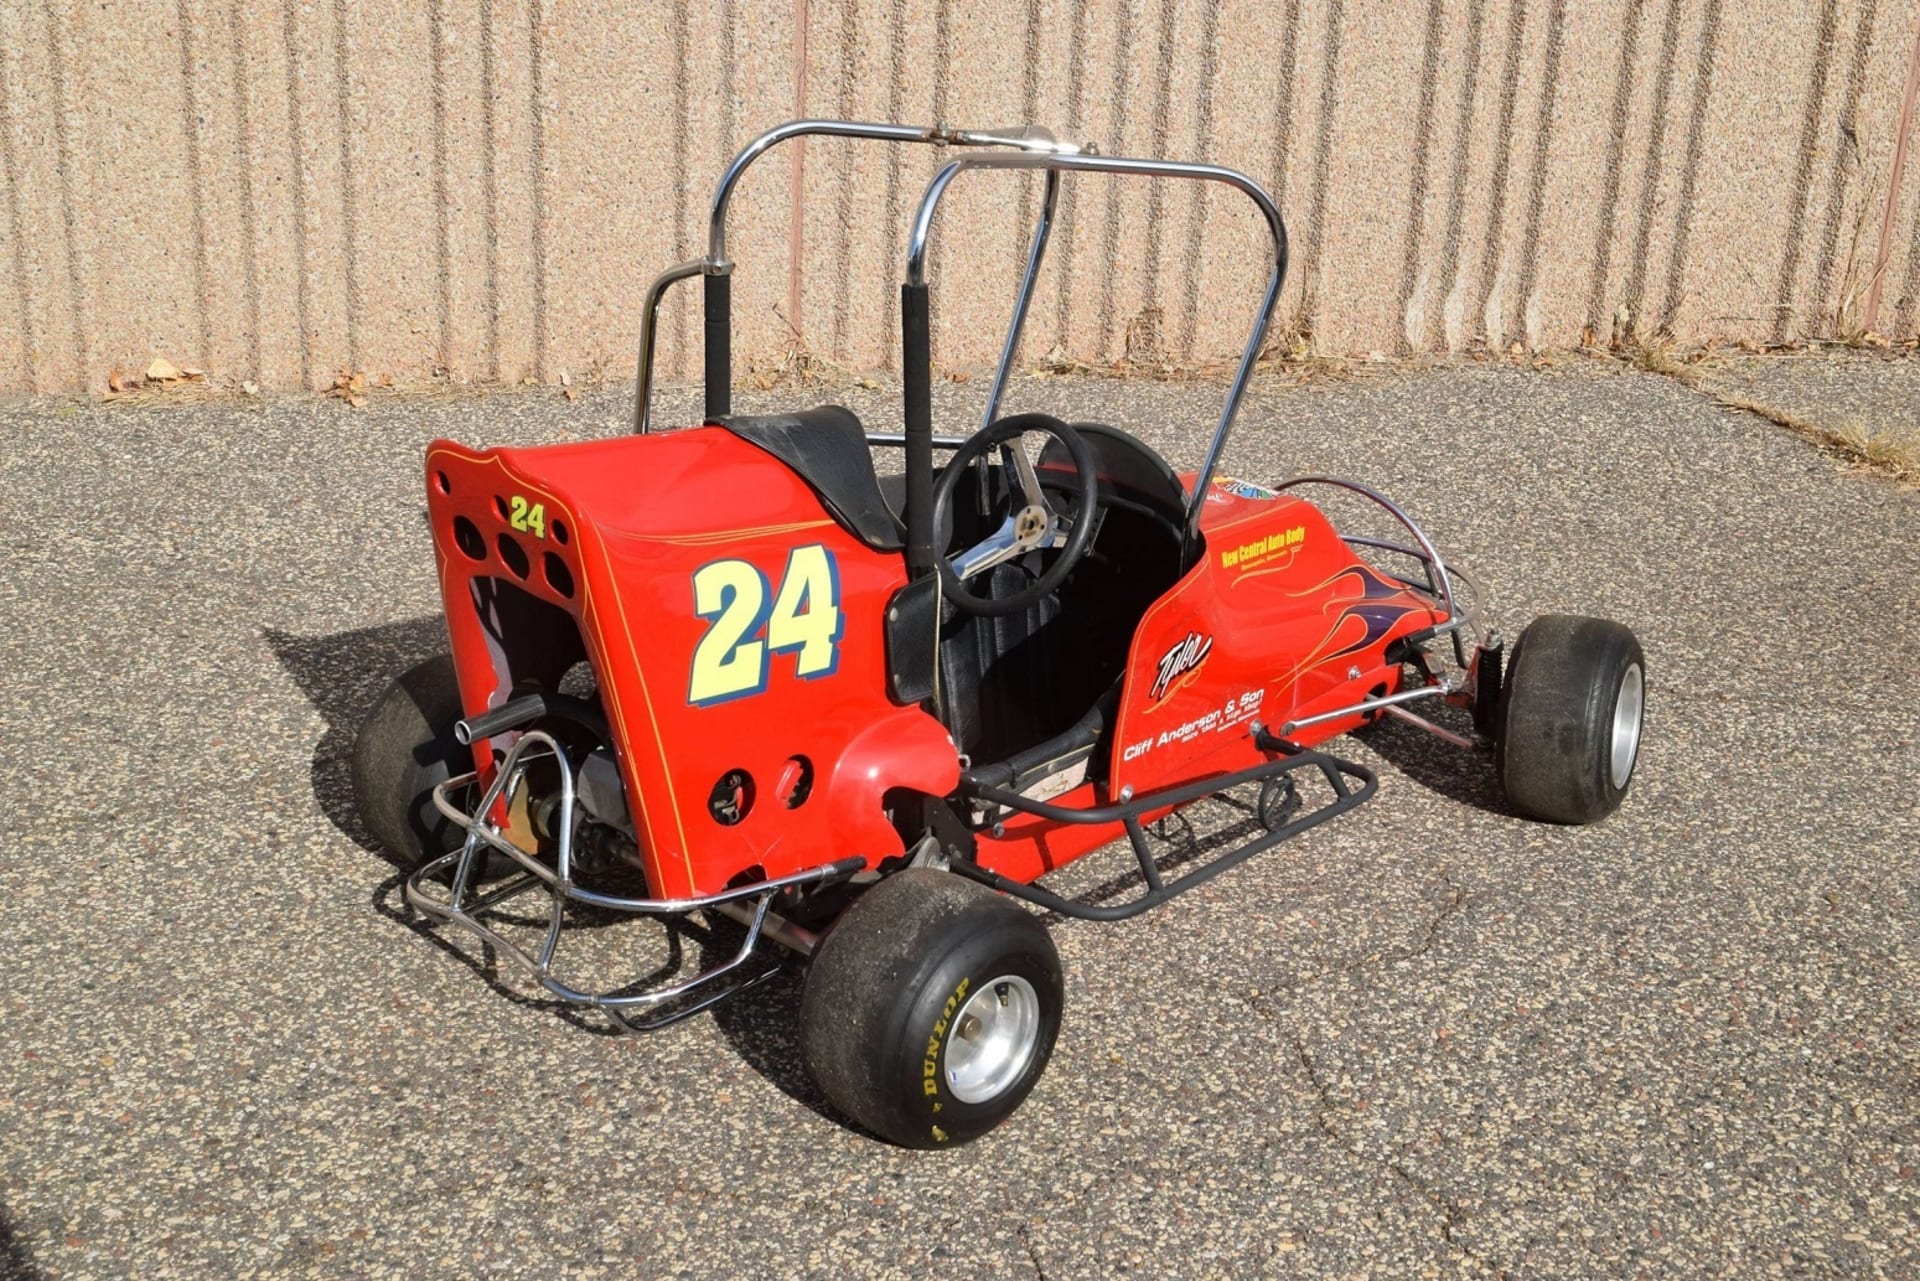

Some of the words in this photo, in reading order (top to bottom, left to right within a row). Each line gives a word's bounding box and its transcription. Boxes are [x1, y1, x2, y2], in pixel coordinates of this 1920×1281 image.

[510, 496, 545, 539] 24
[1221, 549, 1239, 569] New
[1239, 537, 1268, 562] Central
[1268, 533, 1285, 552] Auto
[1286, 526, 1305, 546] Body
[686, 543, 846, 709] 24
[1123, 737, 1154, 761] Cliff
[1156, 709, 1221, 748] Anderson
[1224, 699, 1236, 715] &
[1239, 688, 1265, 707] Son
[923, 977, 970, 1096] DUNLOP
